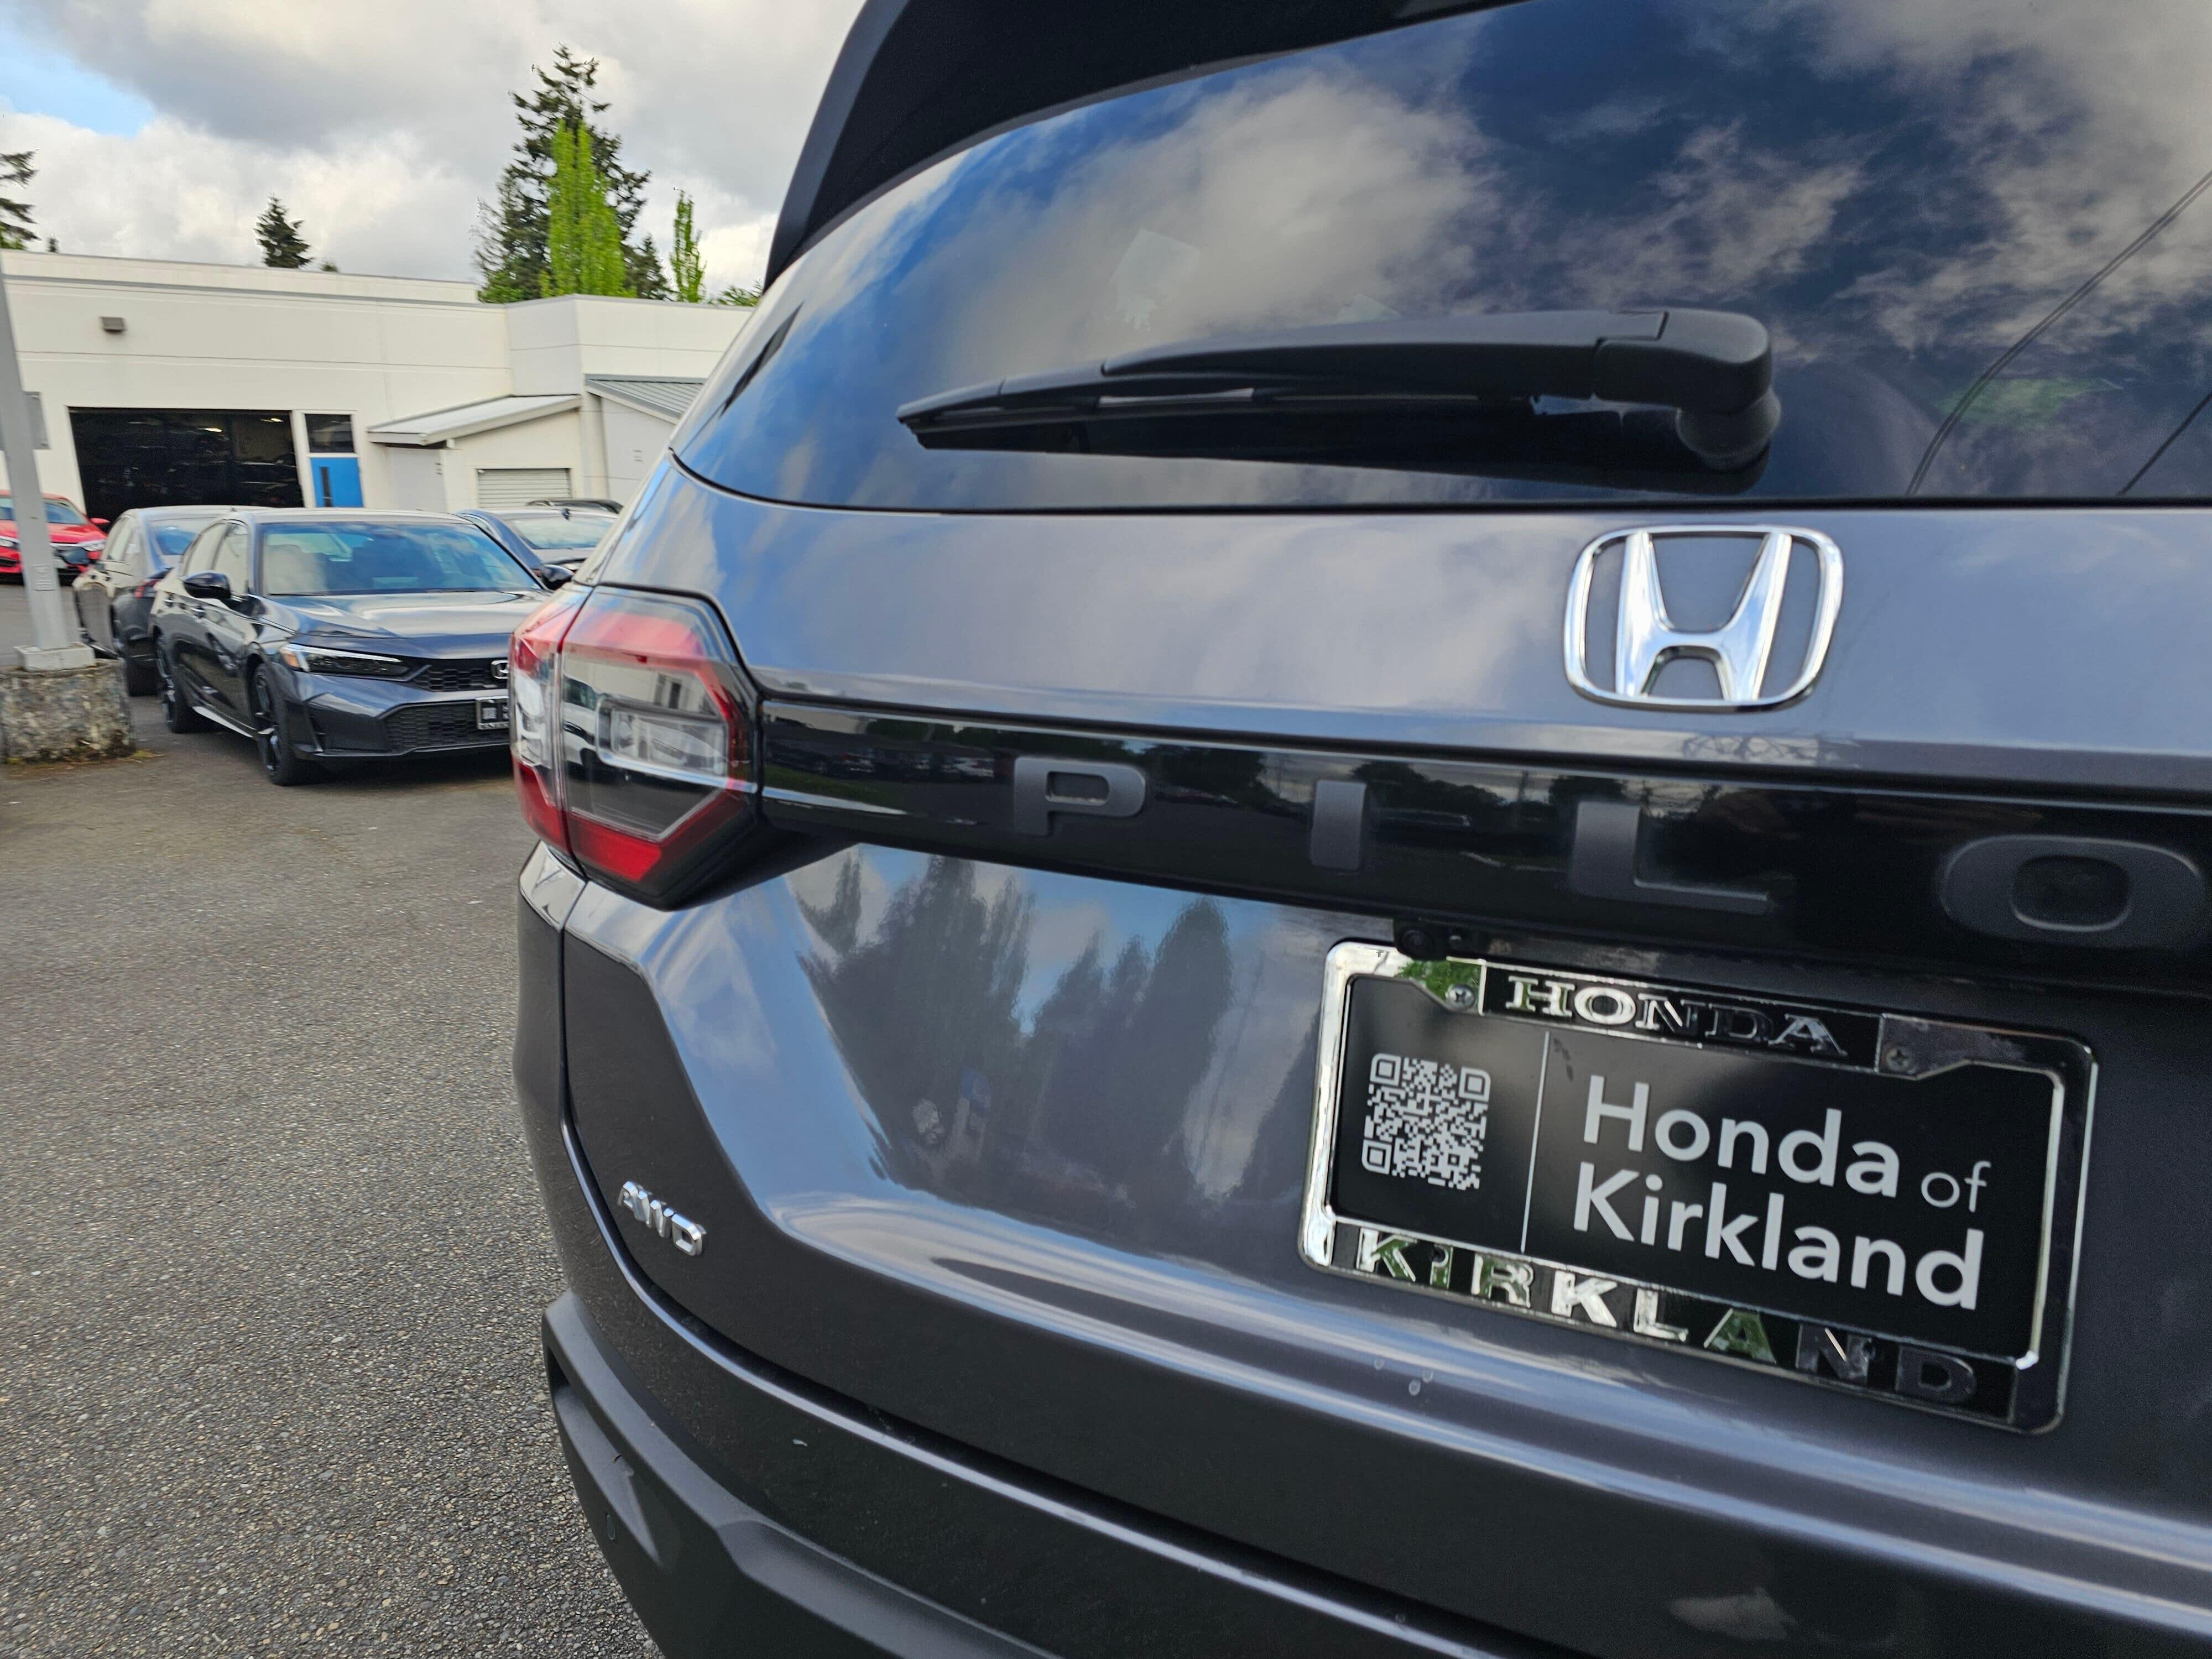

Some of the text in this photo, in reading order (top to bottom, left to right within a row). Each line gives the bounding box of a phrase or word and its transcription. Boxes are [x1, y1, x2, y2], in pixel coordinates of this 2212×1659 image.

[1506, 975, 1848, 1056] HONDA
[1583, 1074, 1992, 1213] Honda of
[617, 1181, 707, 1256] AWD
[1573, 1161, 1984, 1311] Kirkland
[1356, 1227, 1978, 1404] KIRKLAND
